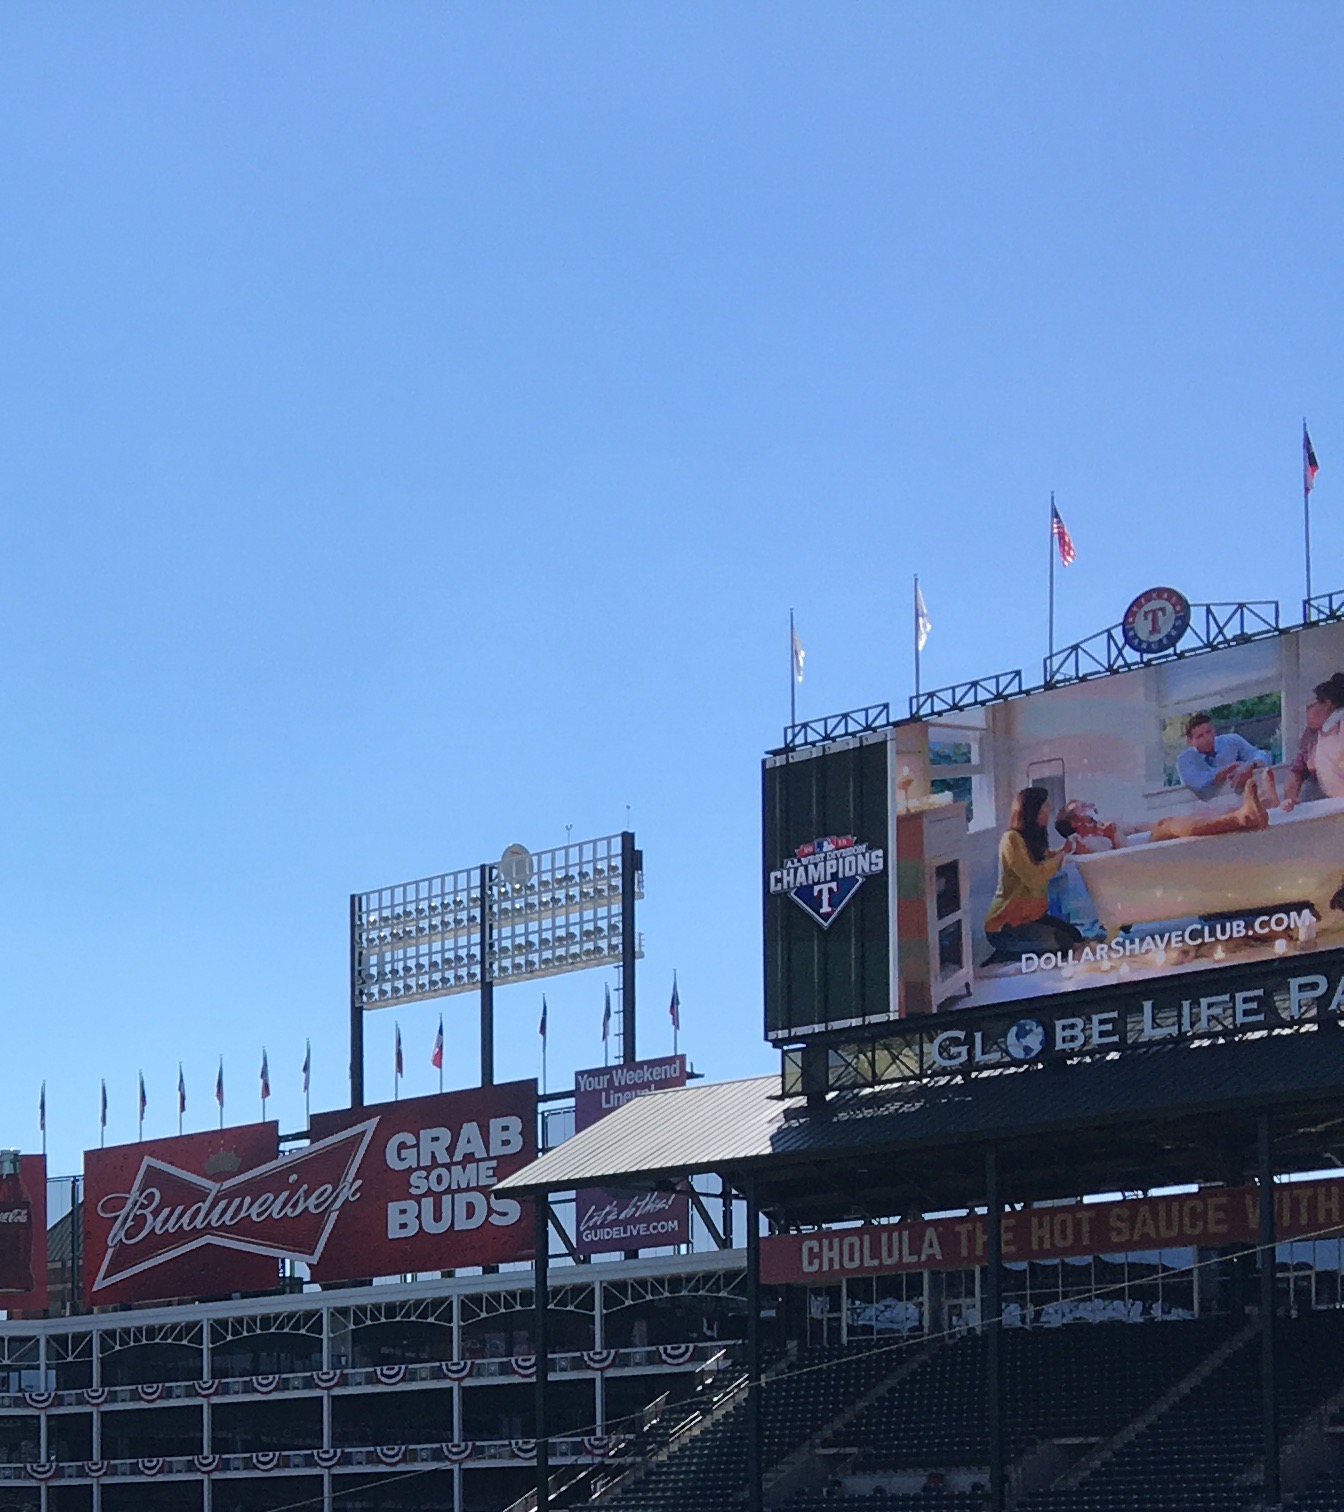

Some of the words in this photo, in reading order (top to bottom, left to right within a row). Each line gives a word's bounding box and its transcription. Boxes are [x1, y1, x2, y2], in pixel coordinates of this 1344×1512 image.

[769, 848, 885, 894] CHAMPIONS
[813, 881, 838, 914] T
[1142, 987, 1265, 1038] LIFE
[577, 1073, 610, 1092] Your
[612, 1060, 680, 1087] Weekend
[385, 1115, 524, 1171] GRAB
[408, 1160, 498, 1195] SOME
[97, 1172, 362, 1248] Budweiser
[386, 1190, 522, 1240] BUDS
[582, 1219, 679, 1243] GUIDELIVE.COM
[801, 1225, 943, 1274] CHOLULA
[1031, 1212, 1095, 1250] HOT
[1110, 1196, 1228, 1243] SAUCE
